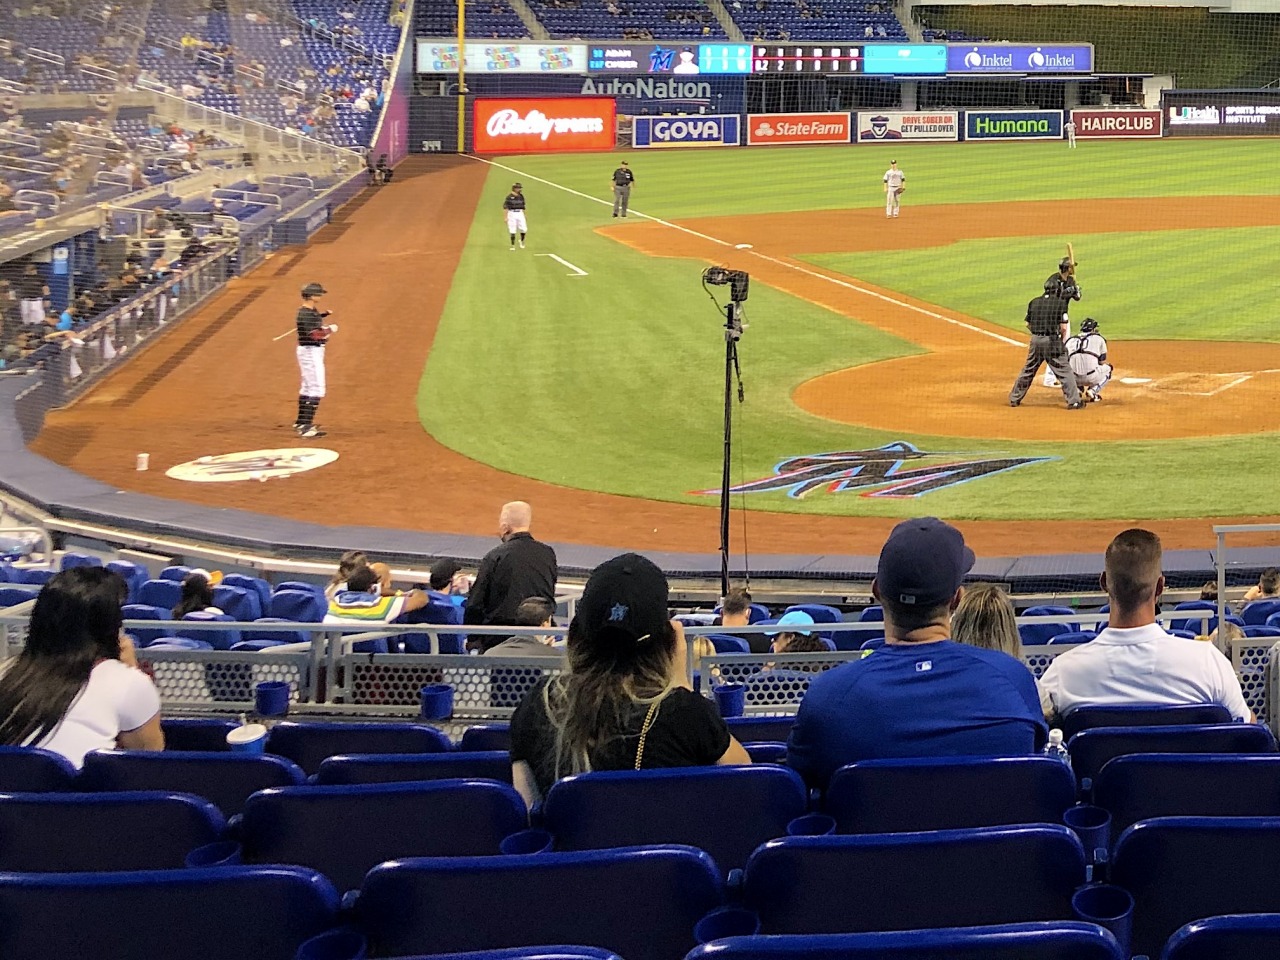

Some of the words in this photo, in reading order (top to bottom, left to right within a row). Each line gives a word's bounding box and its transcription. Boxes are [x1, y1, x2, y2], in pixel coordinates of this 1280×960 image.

[982, 53, 1013, 67] Inktel
[1045, 53, 1075, 67] Inktel
[581, 78, 711, 99] AutoNation
[486, 109, 555, 141] Bally
[554, 117, 604, 134] SPORTS
[902, 116, 921, 124] DRIVE
[922, 116, 943, 124] SOBER
[944, 116, 953, 124] OR
[1081, 116, 1154, 131] HAIRCLUB
[1225, 115, 1266, 124] INSTITUTE
[654, 121, 720, 140] GOYA
[901, 124, 913, 133] GET
[914, 124, 937, 133] PULLED
[938, 124, 954, 133] OVER
[422, 140, 442, 152] 344
